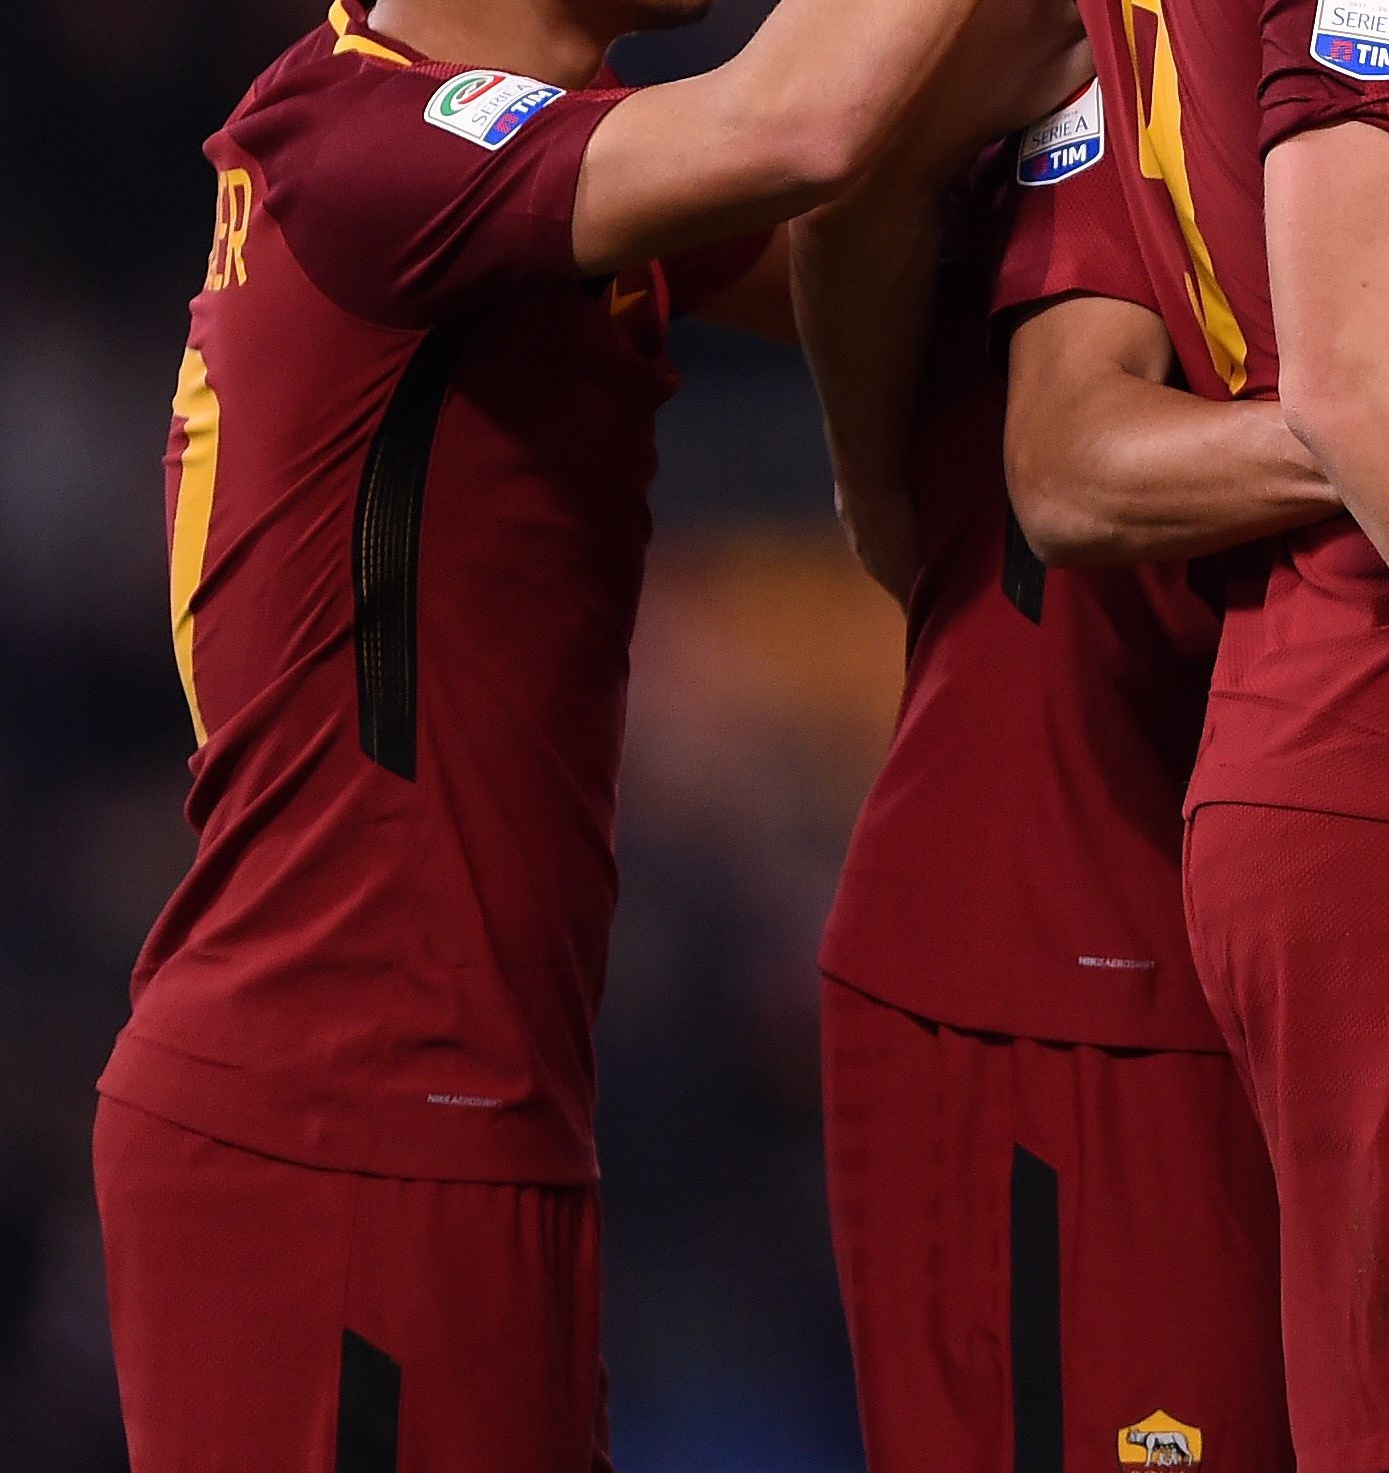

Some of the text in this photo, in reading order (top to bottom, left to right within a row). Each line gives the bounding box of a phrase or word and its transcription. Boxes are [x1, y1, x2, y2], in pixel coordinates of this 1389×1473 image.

[1331, 6, 1389, 34] SERIE
[471, 90, 515, 127] SERIE
[510, 89, 553, 114] TIM
[1032, 121, 1073, 146] SERIE
[1074, 114, 1089, 133] A
[1049, 143, 1087, 171] TIM
